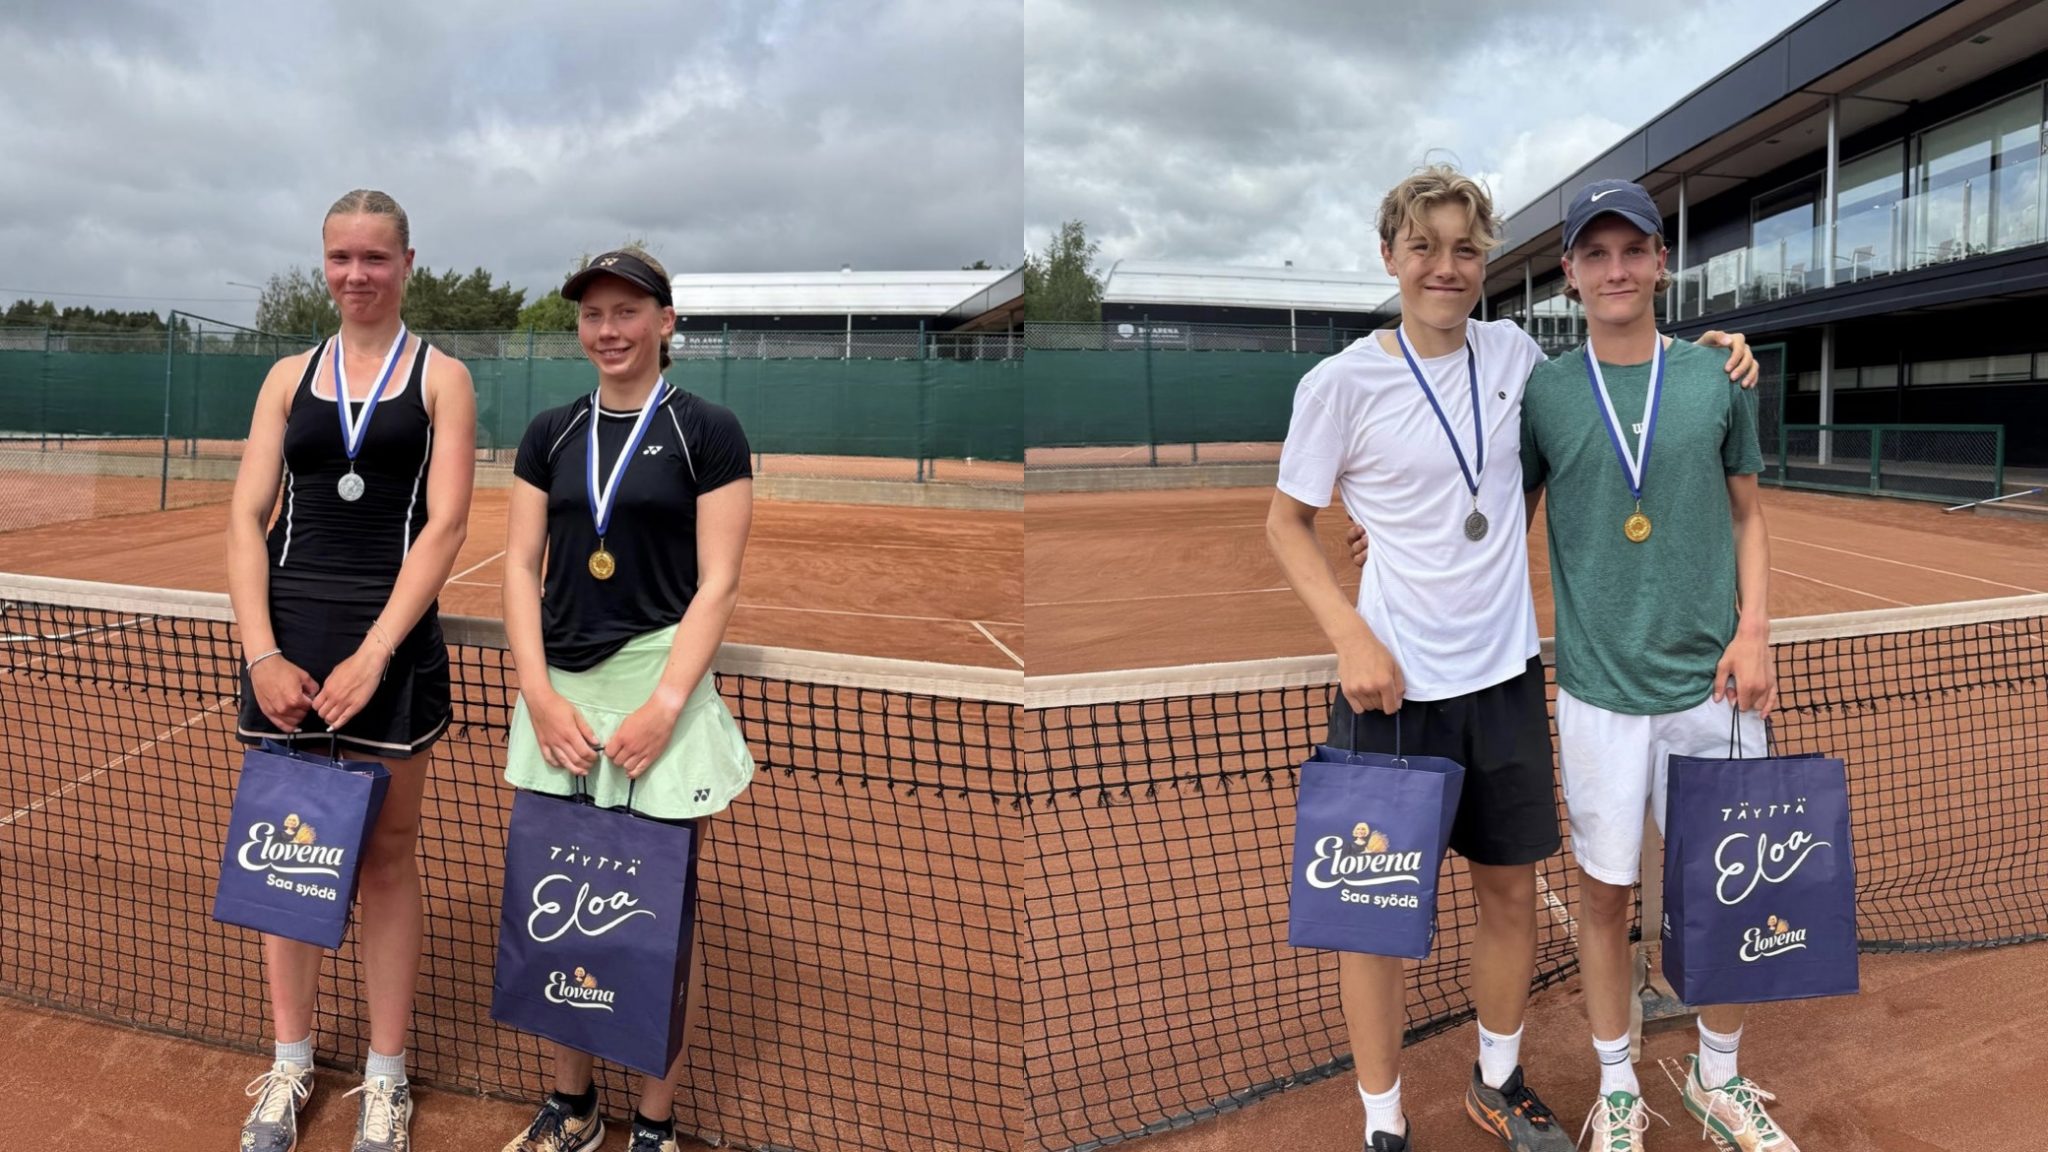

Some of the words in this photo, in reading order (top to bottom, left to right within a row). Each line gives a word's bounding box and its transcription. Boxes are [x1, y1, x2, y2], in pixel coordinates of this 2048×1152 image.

[1721, 797, 1806, 821] TÄYTTÄ
[238, 822, 344, 879] Elovena
[550, 845, 641, 876] TÄYTTÄ
[1306, 836, 1422, 889] Elovena
[1715, 831, 1831, 905] Eloa
[267, 873, 293, 891] Saa
[296, 884, 337, 901] syödä
[1340, 889, 1369, 904] Saa
[1374, 894, 1418, 908] syödä
[528, 874, 656, 942] Eloa
[1740, 927, 1807, 962] Elovena
[544, 971, 615, 1013] Elovena
